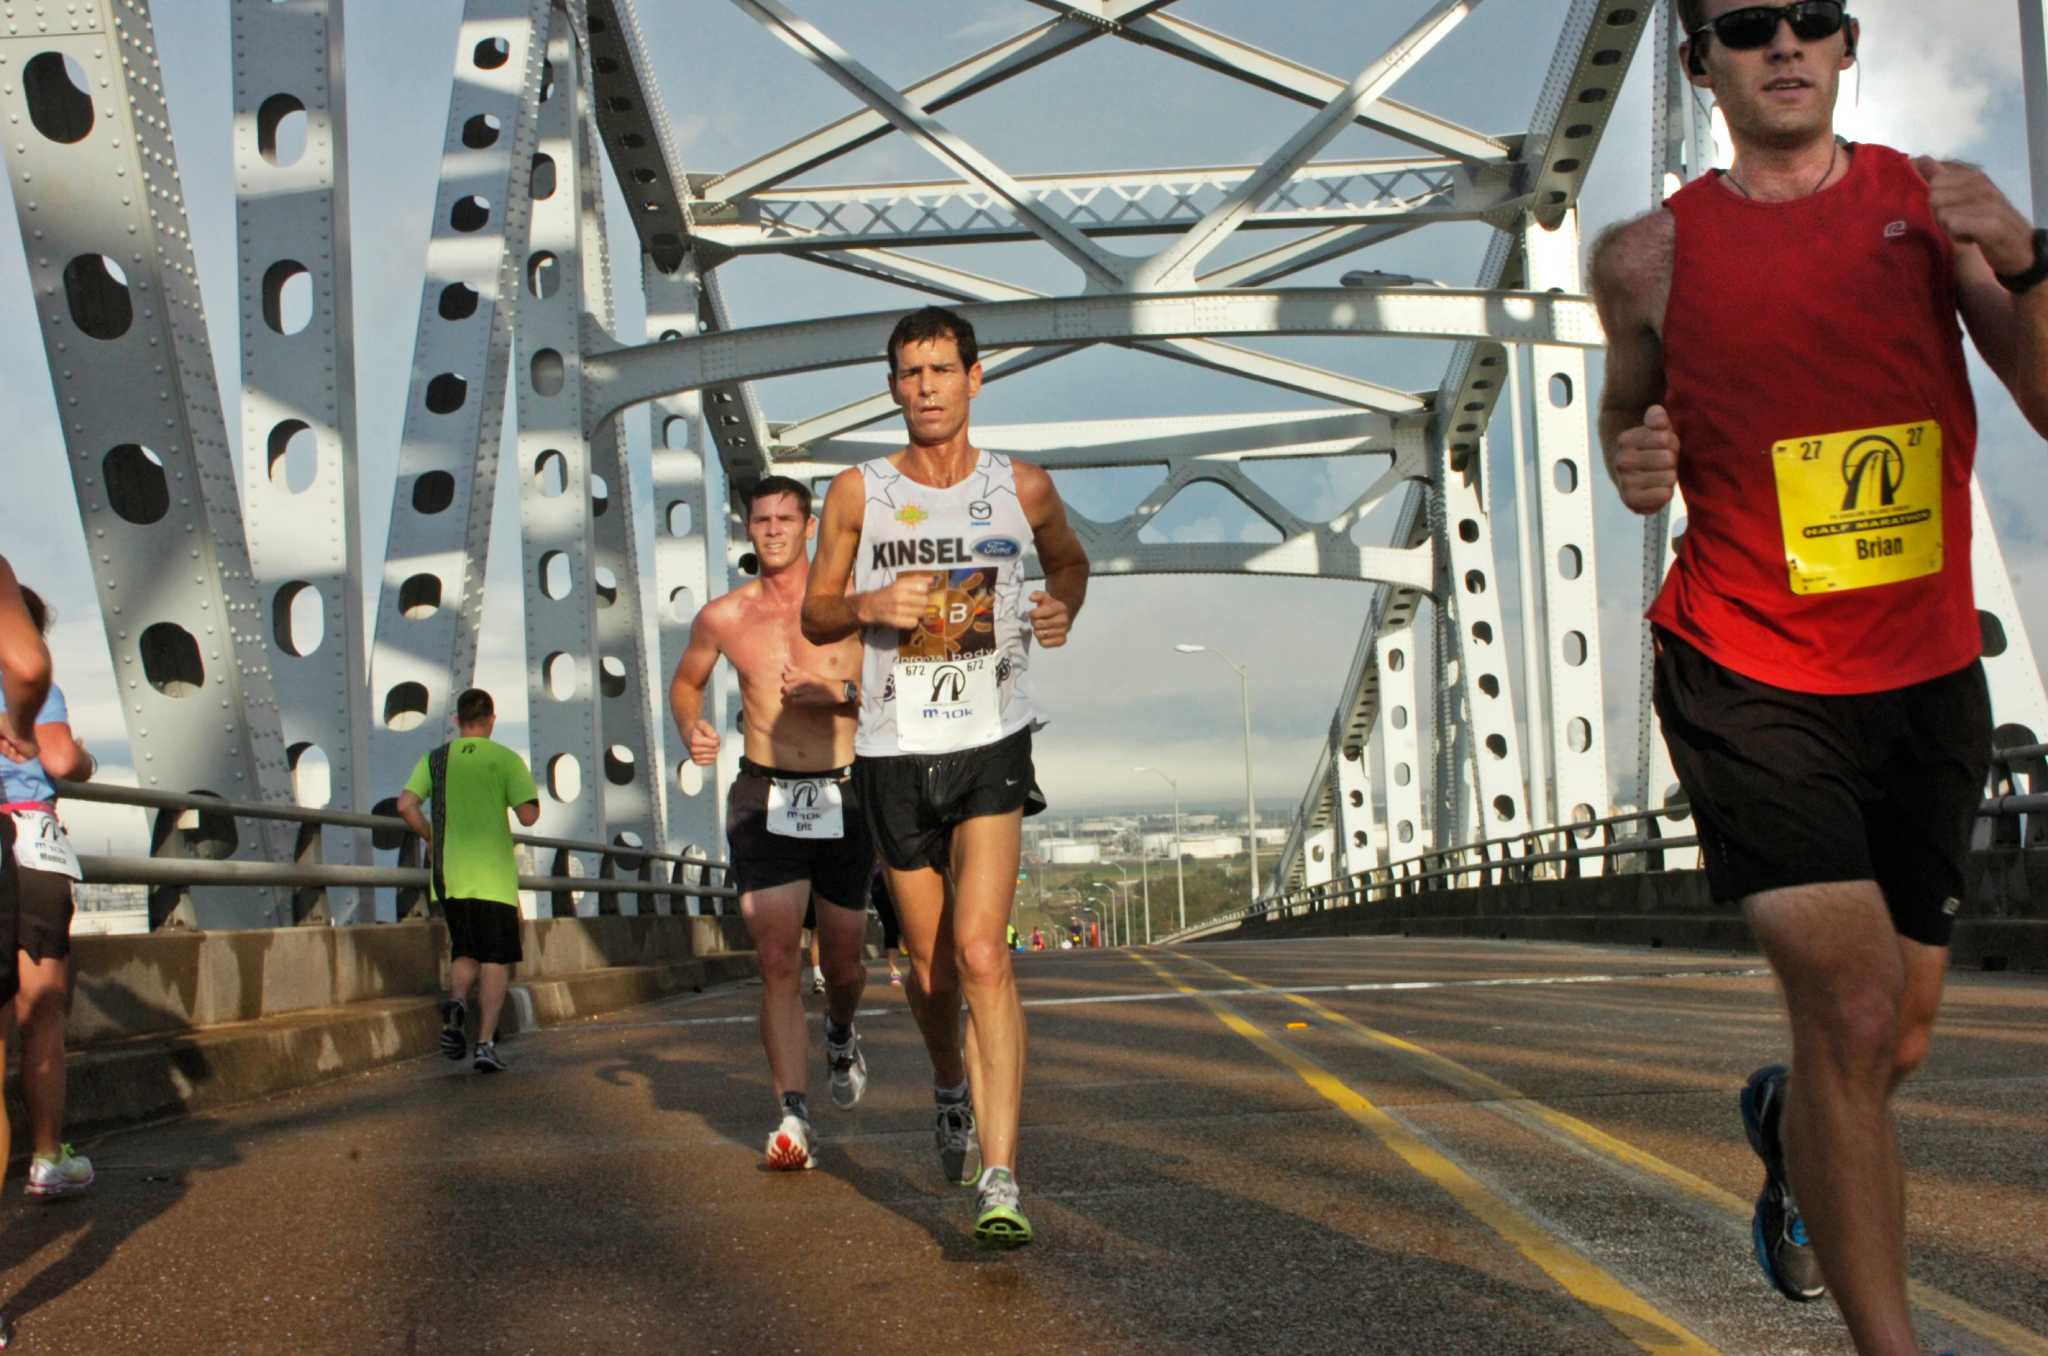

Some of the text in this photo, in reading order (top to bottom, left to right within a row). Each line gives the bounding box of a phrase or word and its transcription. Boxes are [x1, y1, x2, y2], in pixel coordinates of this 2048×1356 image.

[1907, 427, 1924, 447] 27
[1800, 441, 1822, 461] 27
[1804, 523, 1854, 536] HALF
[1856, 511, 1930, 529] MARATHON
[872, 537, 972, 570] KINSEL
[1856, 537, 1903, 560] Brian
[906, 666, 925, 676] 672
[967, 660, 984, 671] 672
